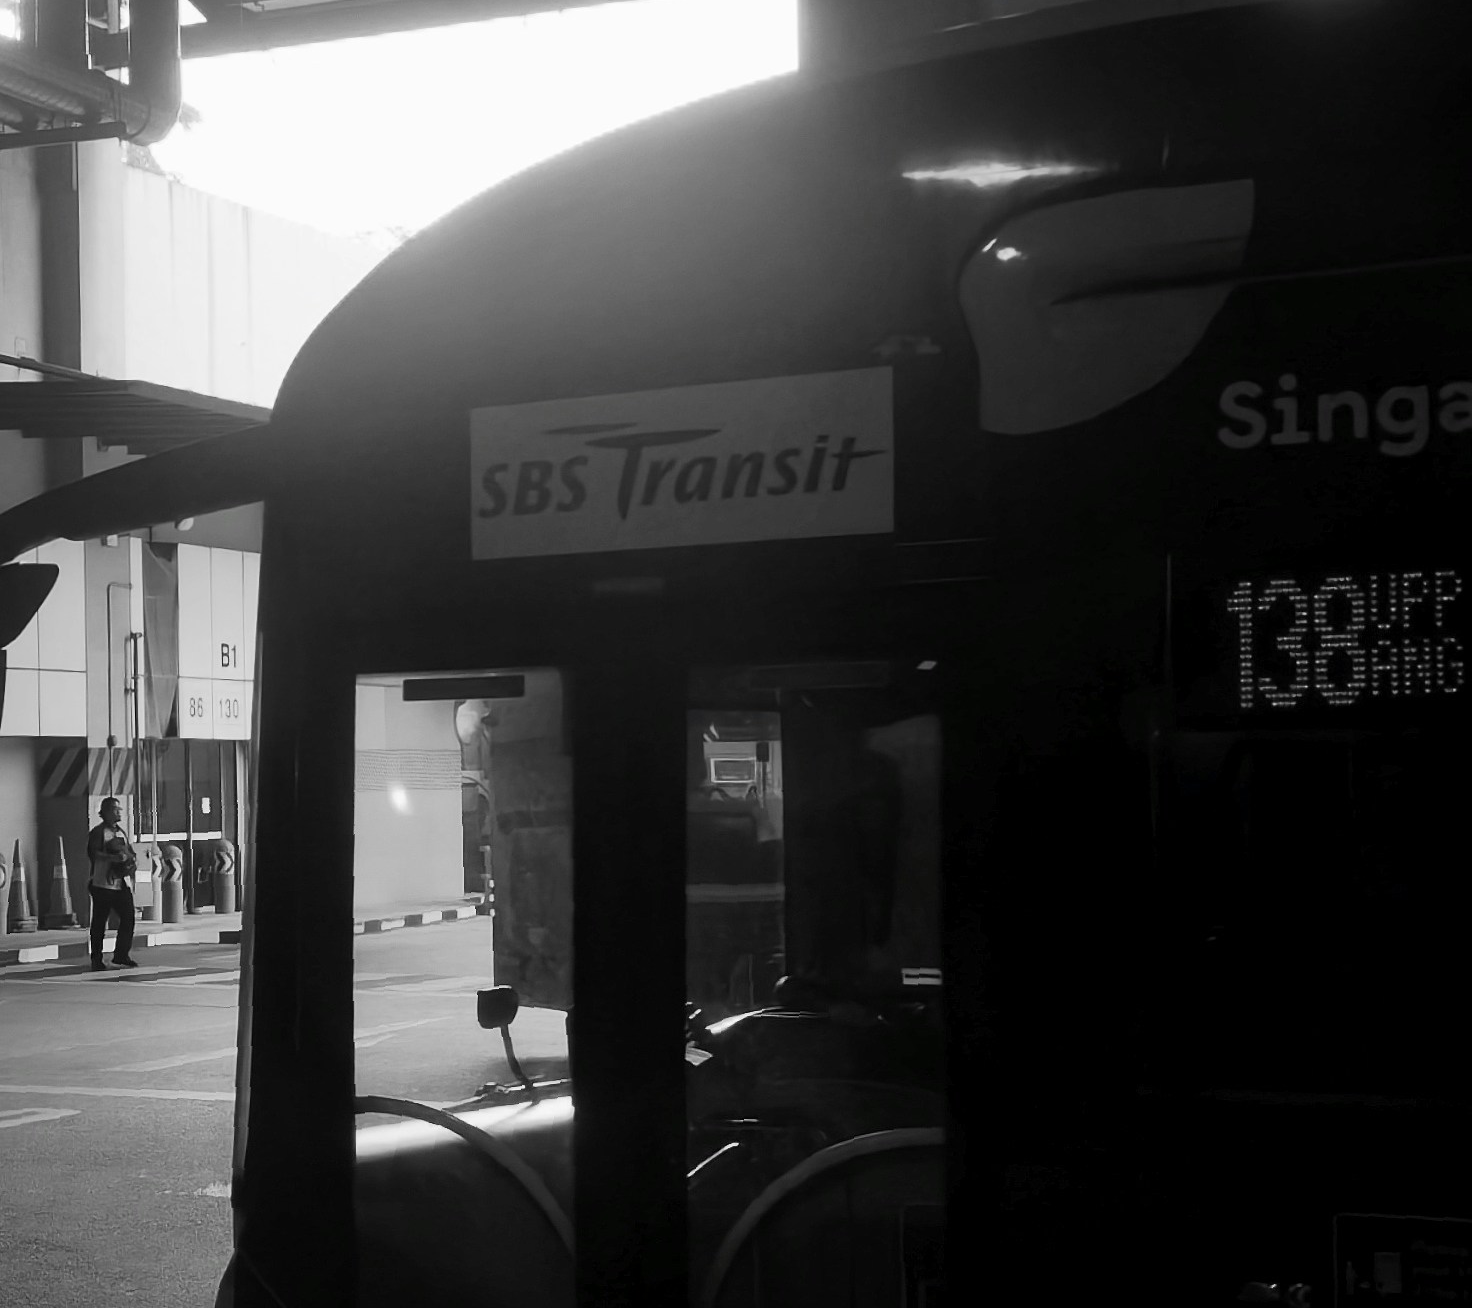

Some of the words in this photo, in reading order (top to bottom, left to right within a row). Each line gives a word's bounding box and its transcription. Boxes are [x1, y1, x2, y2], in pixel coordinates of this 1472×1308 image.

[478, 455, 588, 519] SBS
[584, 428, 888, 521] Transit
[221, 643, 237, 668] B1
[1227, 576, 1366, 709] 138
[1369, 635, 1465, 696] ANG
[219, 698, 240, 719] 130
